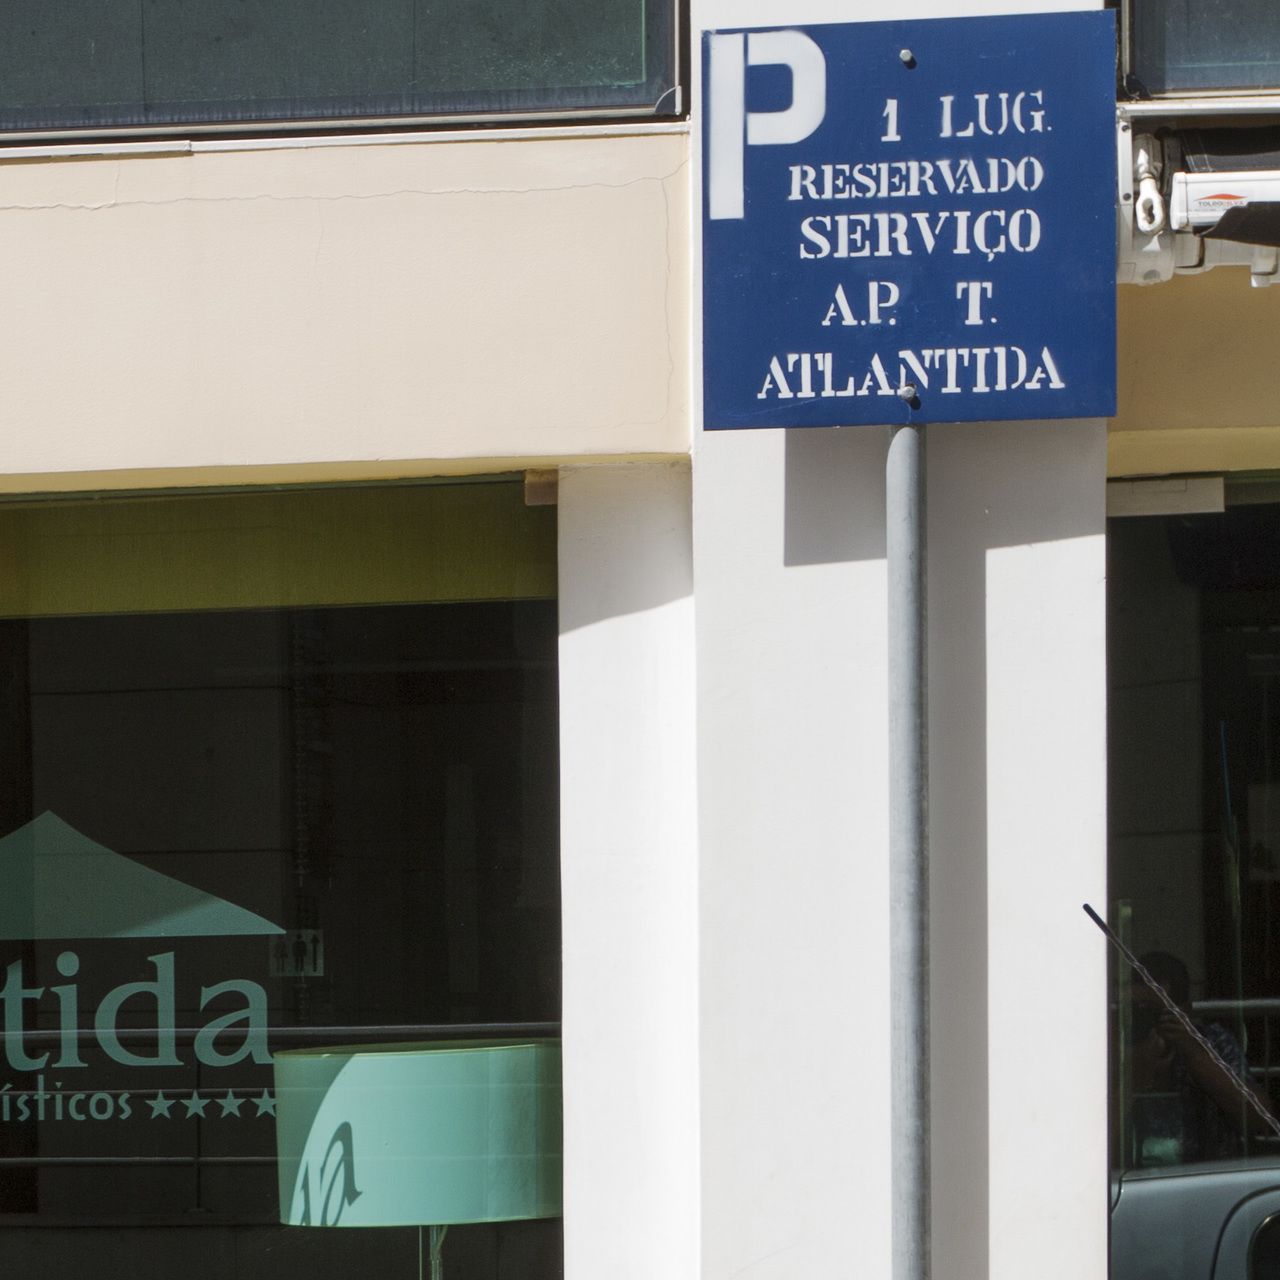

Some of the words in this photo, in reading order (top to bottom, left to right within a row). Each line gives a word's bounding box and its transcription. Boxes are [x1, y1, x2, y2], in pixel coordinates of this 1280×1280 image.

[710, 31, 826, 220] P
[881, 99, 901, 142] 1
[940, 91, 1052, 139] LUG.
[787, 157, 1044, 202] RESERVADO
[799, 208, 1042, 263] SERVIÇO
[956, 281, 997, 325] T.
[757, 345, 1065, 400] ATLANTIDA
